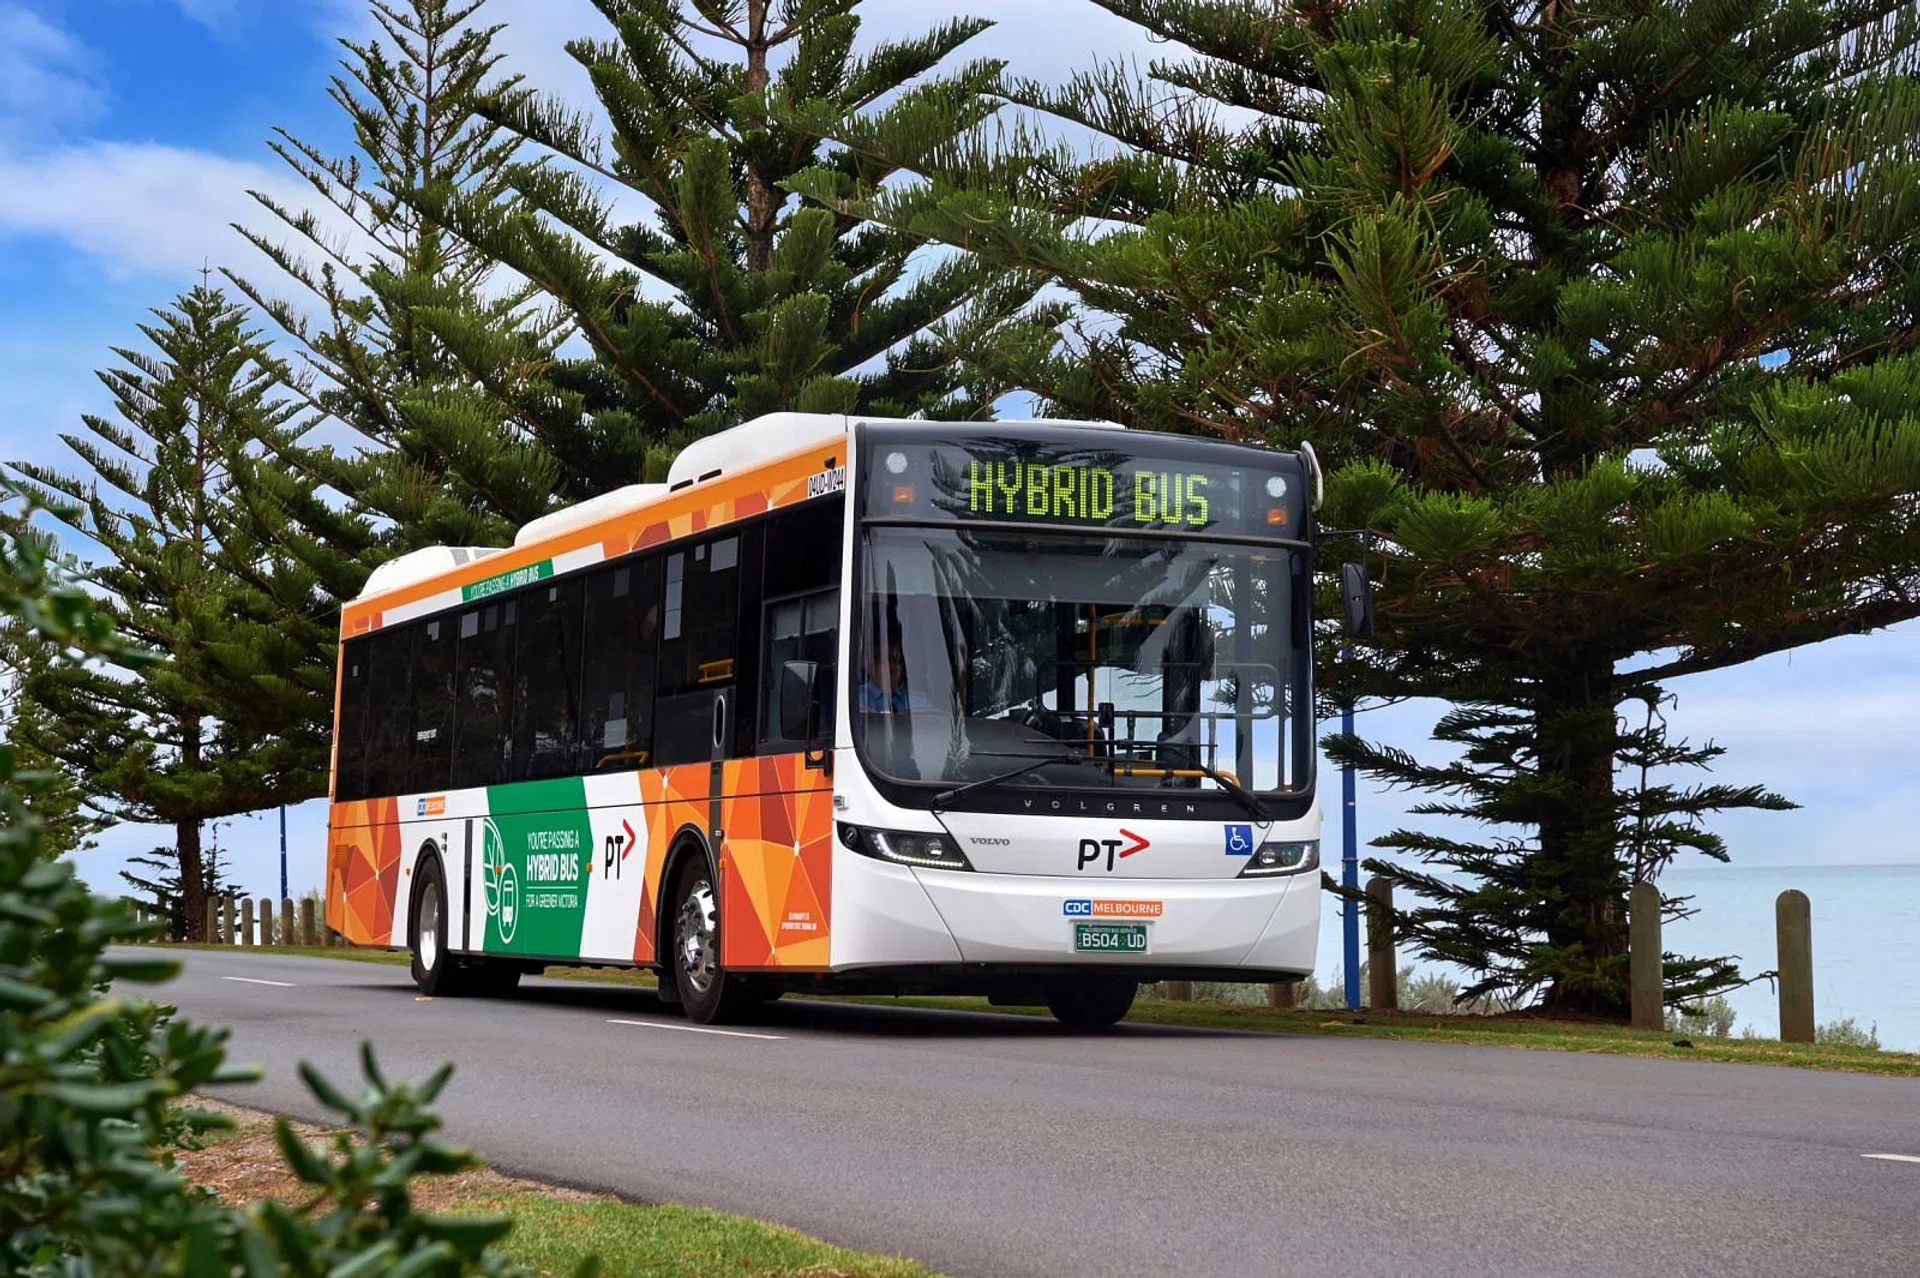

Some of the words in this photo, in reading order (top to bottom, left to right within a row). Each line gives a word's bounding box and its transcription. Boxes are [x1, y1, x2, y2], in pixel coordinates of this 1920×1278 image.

[970, 460, 1113, 519] HYBRID
[1135, 470, 1209, 525] BUS
[1024, 800, 1195, 813] VOLGREN
[548, 830, 574, 849] PASSING
[574, 829, 580, 849] A
[970, 837, 1011, 846] VOLVO
[526, 853, 559, 881] HYBRID
[559, 852, 579, 881] BUS
[1065, 902, 1090, 913] CDC
[1093, 903, 1161, 914] MELBOURNE
[1127, 934, 1145, 948] UD
